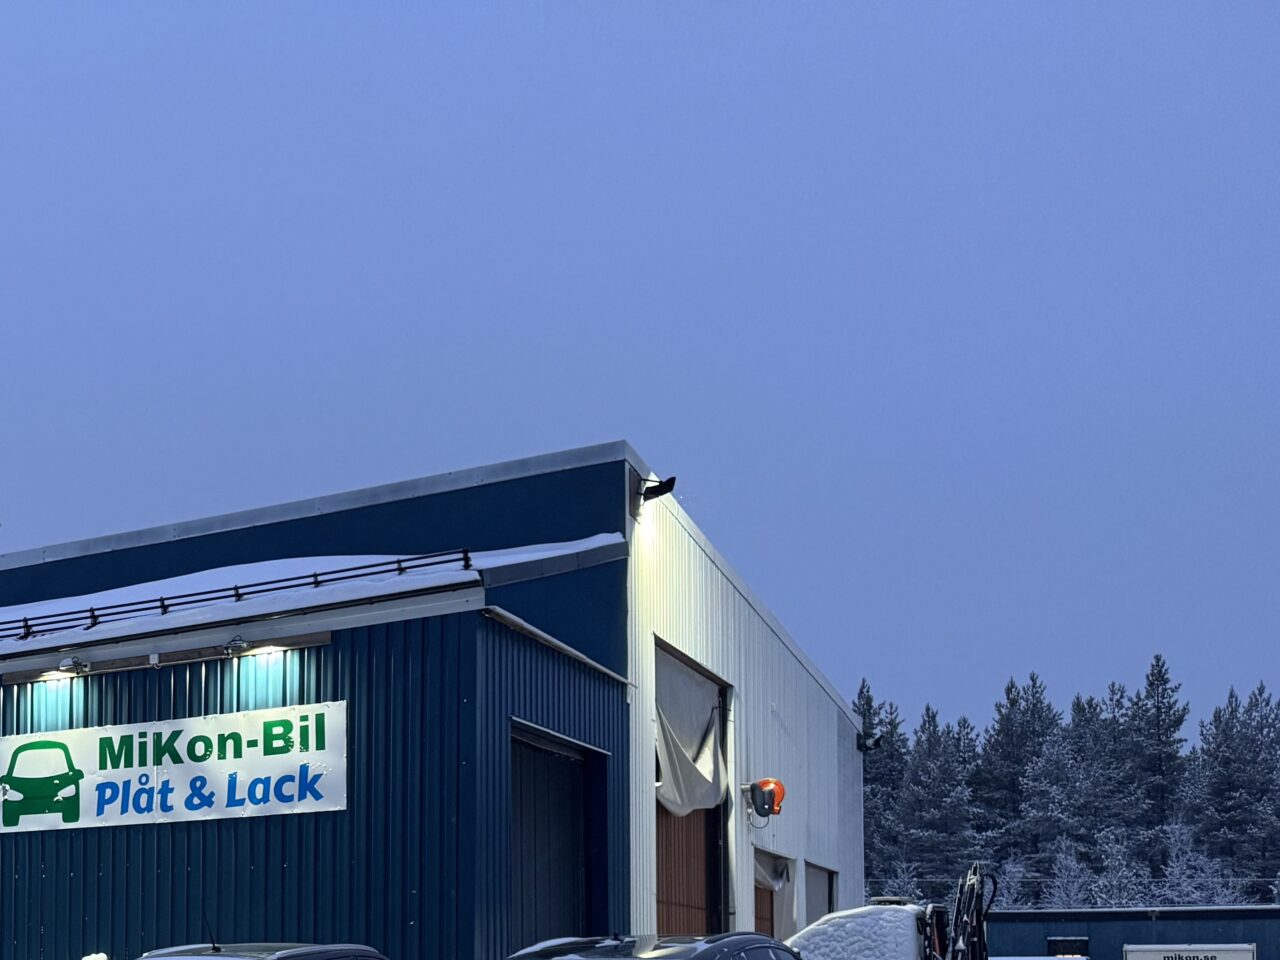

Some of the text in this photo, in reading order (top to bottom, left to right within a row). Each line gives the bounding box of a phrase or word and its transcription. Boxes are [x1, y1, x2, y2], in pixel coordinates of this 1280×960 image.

[98, 712, 326, 770] MiKon-Bil
[95, 763, 324, 817] Plåt & Lack
